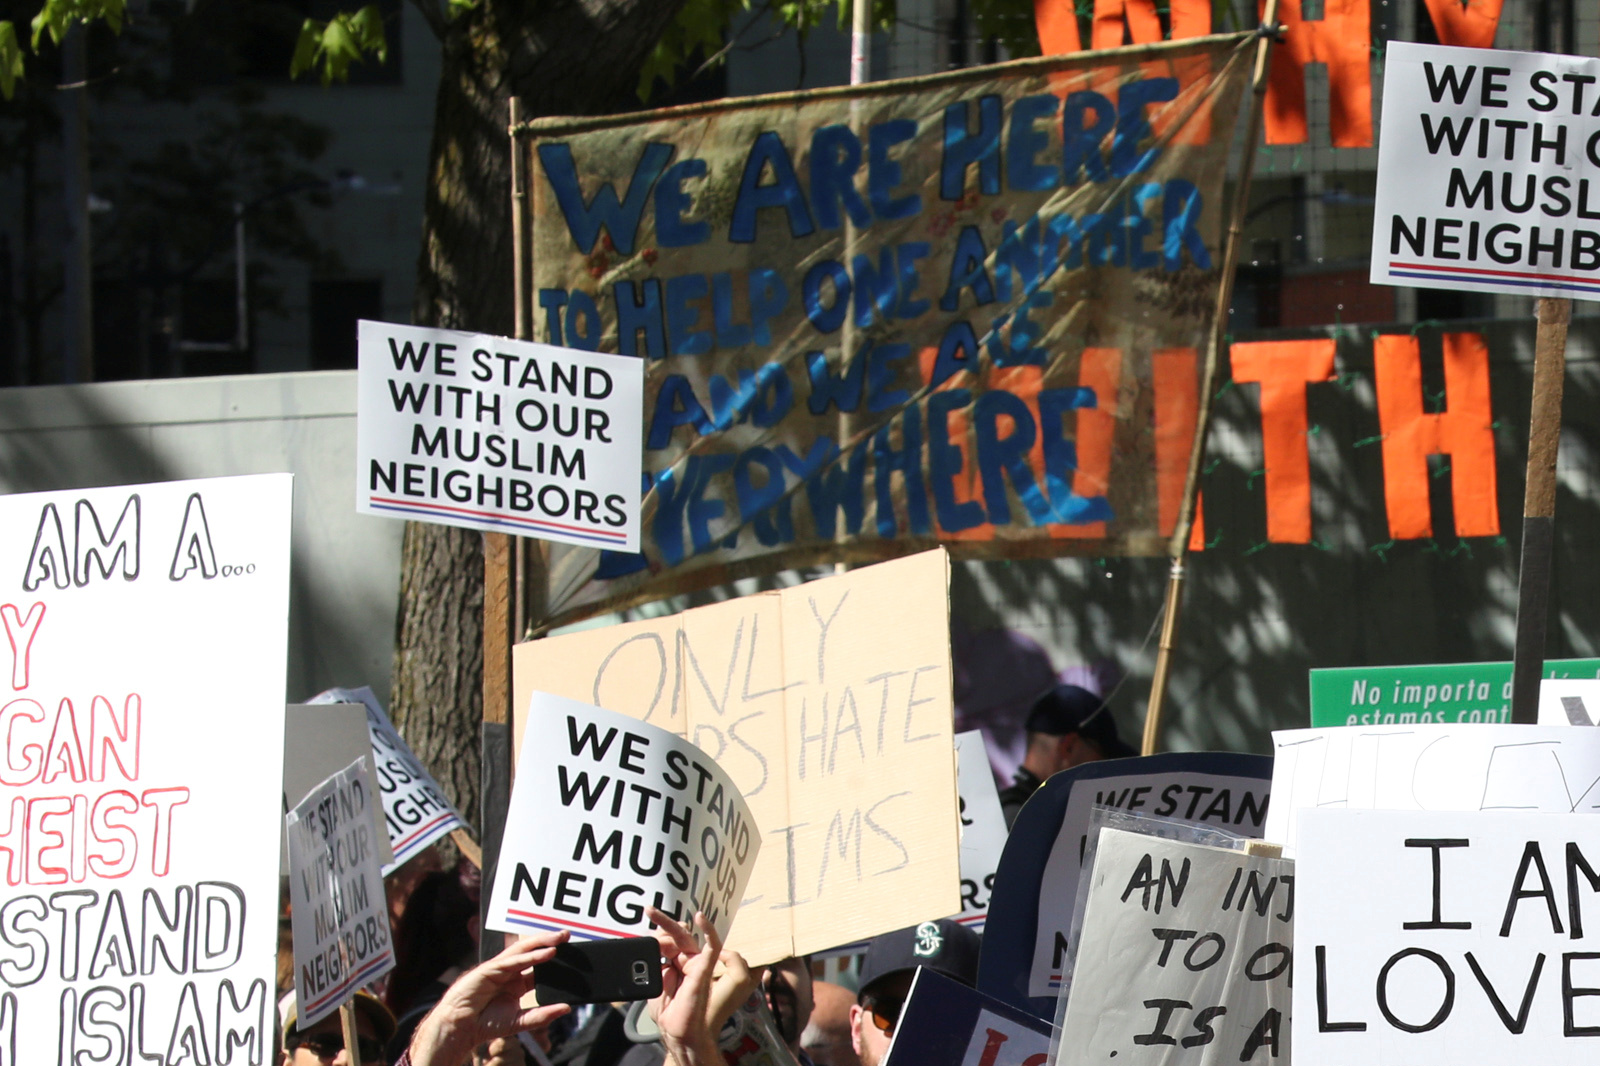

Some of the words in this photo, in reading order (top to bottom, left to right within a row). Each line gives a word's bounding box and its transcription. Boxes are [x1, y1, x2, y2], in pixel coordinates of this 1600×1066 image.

[1422, 60, 1510, 108] WE
[537, 142, 711, 255] WE
[728, 120, 922, 242] ARE
[940, 77, 1178, 199] HERE
[1420, 113, 1568, 166] WITH
[539, 288, 599, 354] TO
[614, 268, 791, 361] HELP
[804, 241, 931, 333] ONE
[388, 337, 457, 376] WE
[472, 348, 613, 400] STAND
[648, 360, 791, 452] AND
[806, 335, 911, 414] WE
[388, 379, 500, 426] WITH
[515, 398, 612, 443] OUR
[411, 423, 586, 480] MUSLIM
[370, 459, 627, 527] NEIGHBORS
[22, 493, 141, 592] AM
[592, 588, 850, 722] ONLY
[1352, 680, 1381, 706] No
[1394, 679, 1491, 709] importa
[799, 665, 943, 782] HATE
[567, 715, 650, 775] WE
[662, 750, 750, 865] STAND
[1096, 785, 1153, 813] WE
[558, 765, 692, 844] WITH
[701, 826, 737, 917] OUR
[1120, 853, 1191, 915] AN
[1402, 836, 1472, 932] I
[0, 881, 247, 988] STAND
[302, 909, 389, 1001] NEIGHBORS
[1152, 928, 1226, 972] TO
[1133, 998, 1227, 1050] IS
